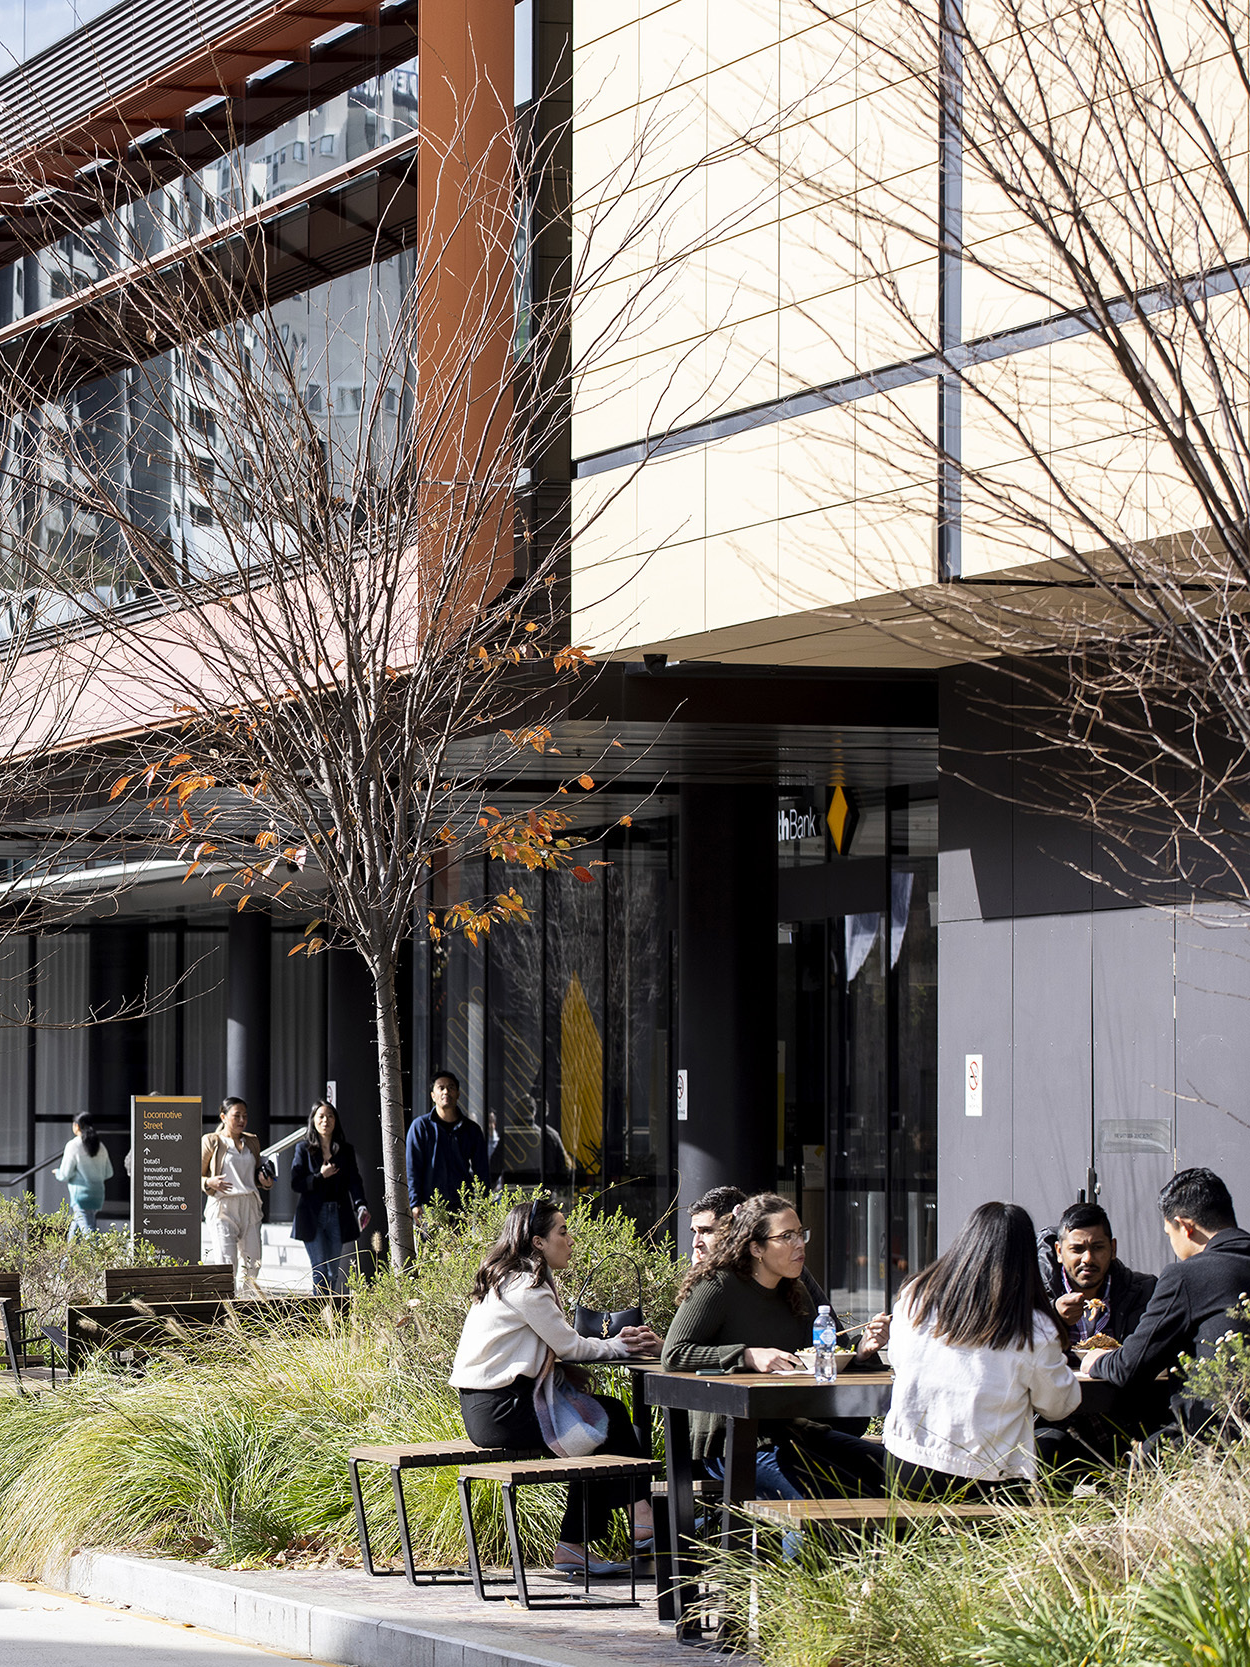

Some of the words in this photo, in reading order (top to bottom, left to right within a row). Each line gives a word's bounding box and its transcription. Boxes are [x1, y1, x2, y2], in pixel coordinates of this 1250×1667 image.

[143, 1110, 182, 1119] Locomotive
[143, 1120, 163, 1130] Street
[143, 1132, 159, 1140] South
[160, 1132, 182, 1142] Eveleigh
